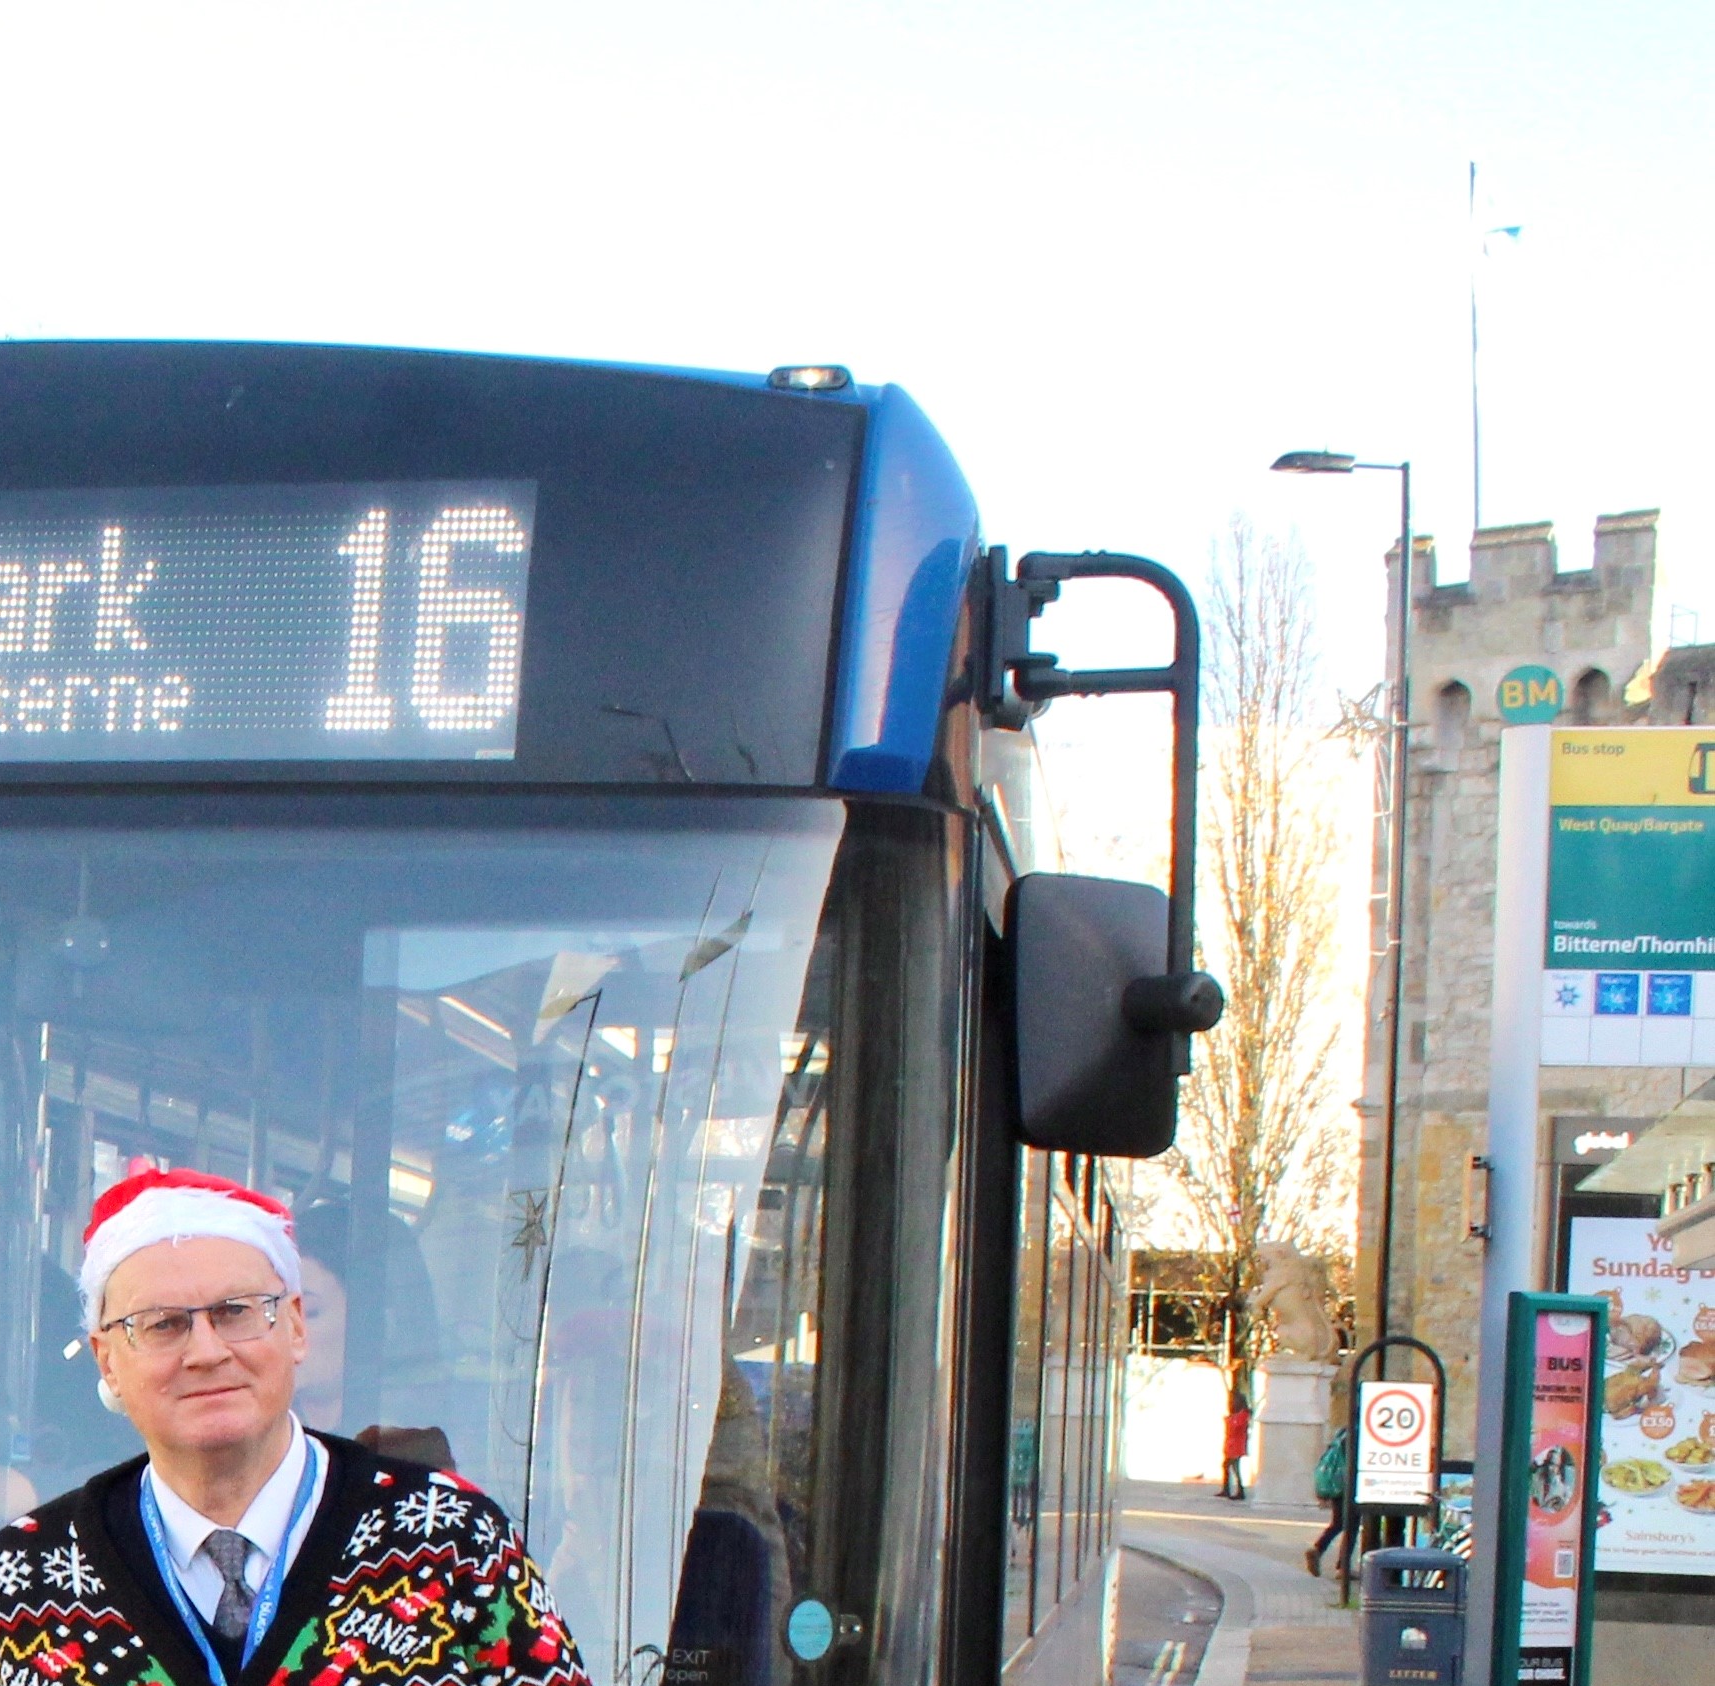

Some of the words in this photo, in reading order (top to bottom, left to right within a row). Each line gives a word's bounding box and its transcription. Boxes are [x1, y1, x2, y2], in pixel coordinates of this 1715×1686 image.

[321, 504, 527, 733] 16
[1501, 678, 1557, 709] BM
[1562, 742, 1589, 755] Bus
[1593, 742, 1625, 758] stop
[1558, 816, 1596, 832] West
[1599, 816, 1705, 835] Quay/Bargate
[1553, 919, 1597, 930] towards
[1553, 934, 1715, 955] Bitterne/Thornhi
[1592, 1257, 1691, 1284] Sunday
[1547, 1357, 1583, 1372] BUS
[1377, 1407, 1415, 1430] 20
[1366, 1451, 1422, 1467] ZONE
[338, 1606, 432, 1664] BANG!
[671, 1649, 711, 1665] EXIT
[666, 1669, 709, 1683] open
